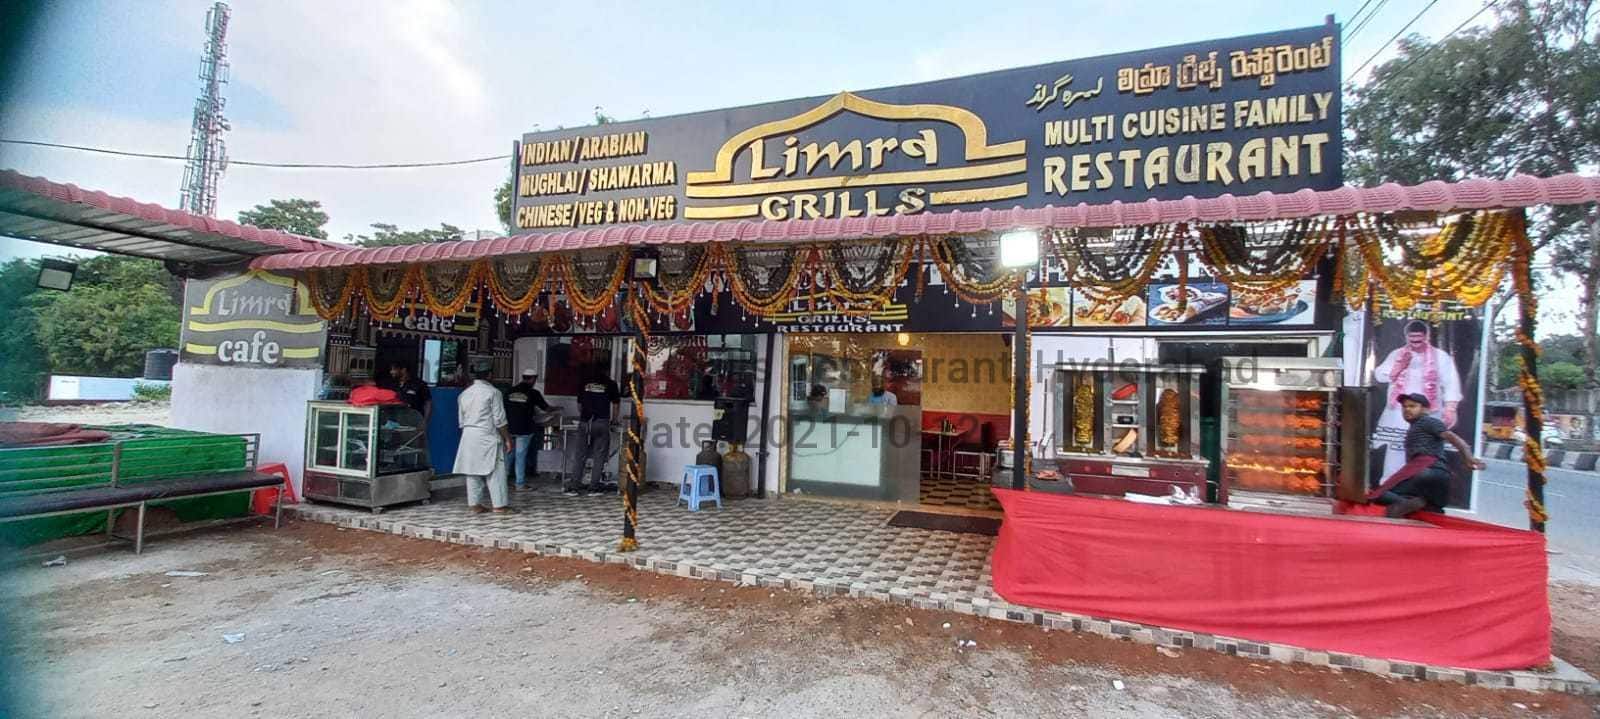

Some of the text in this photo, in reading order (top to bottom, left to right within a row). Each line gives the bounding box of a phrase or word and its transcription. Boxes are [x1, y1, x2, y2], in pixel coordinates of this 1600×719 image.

[1045, 91, 1334, 147] MULTI CUISINE FAMILY
[1043, 132, 1329, 197] RESTAURANT
[605, 200, 615, 223] &
[618, 195, 675, 222] NON-VEG
[761, 187, 926, 221] GRILLS
[777, 324, 904, 333] RESTAURANT
[1382, 309, 1464, 320] RESTAUANT
[218, 330, 280, 364] cafe
